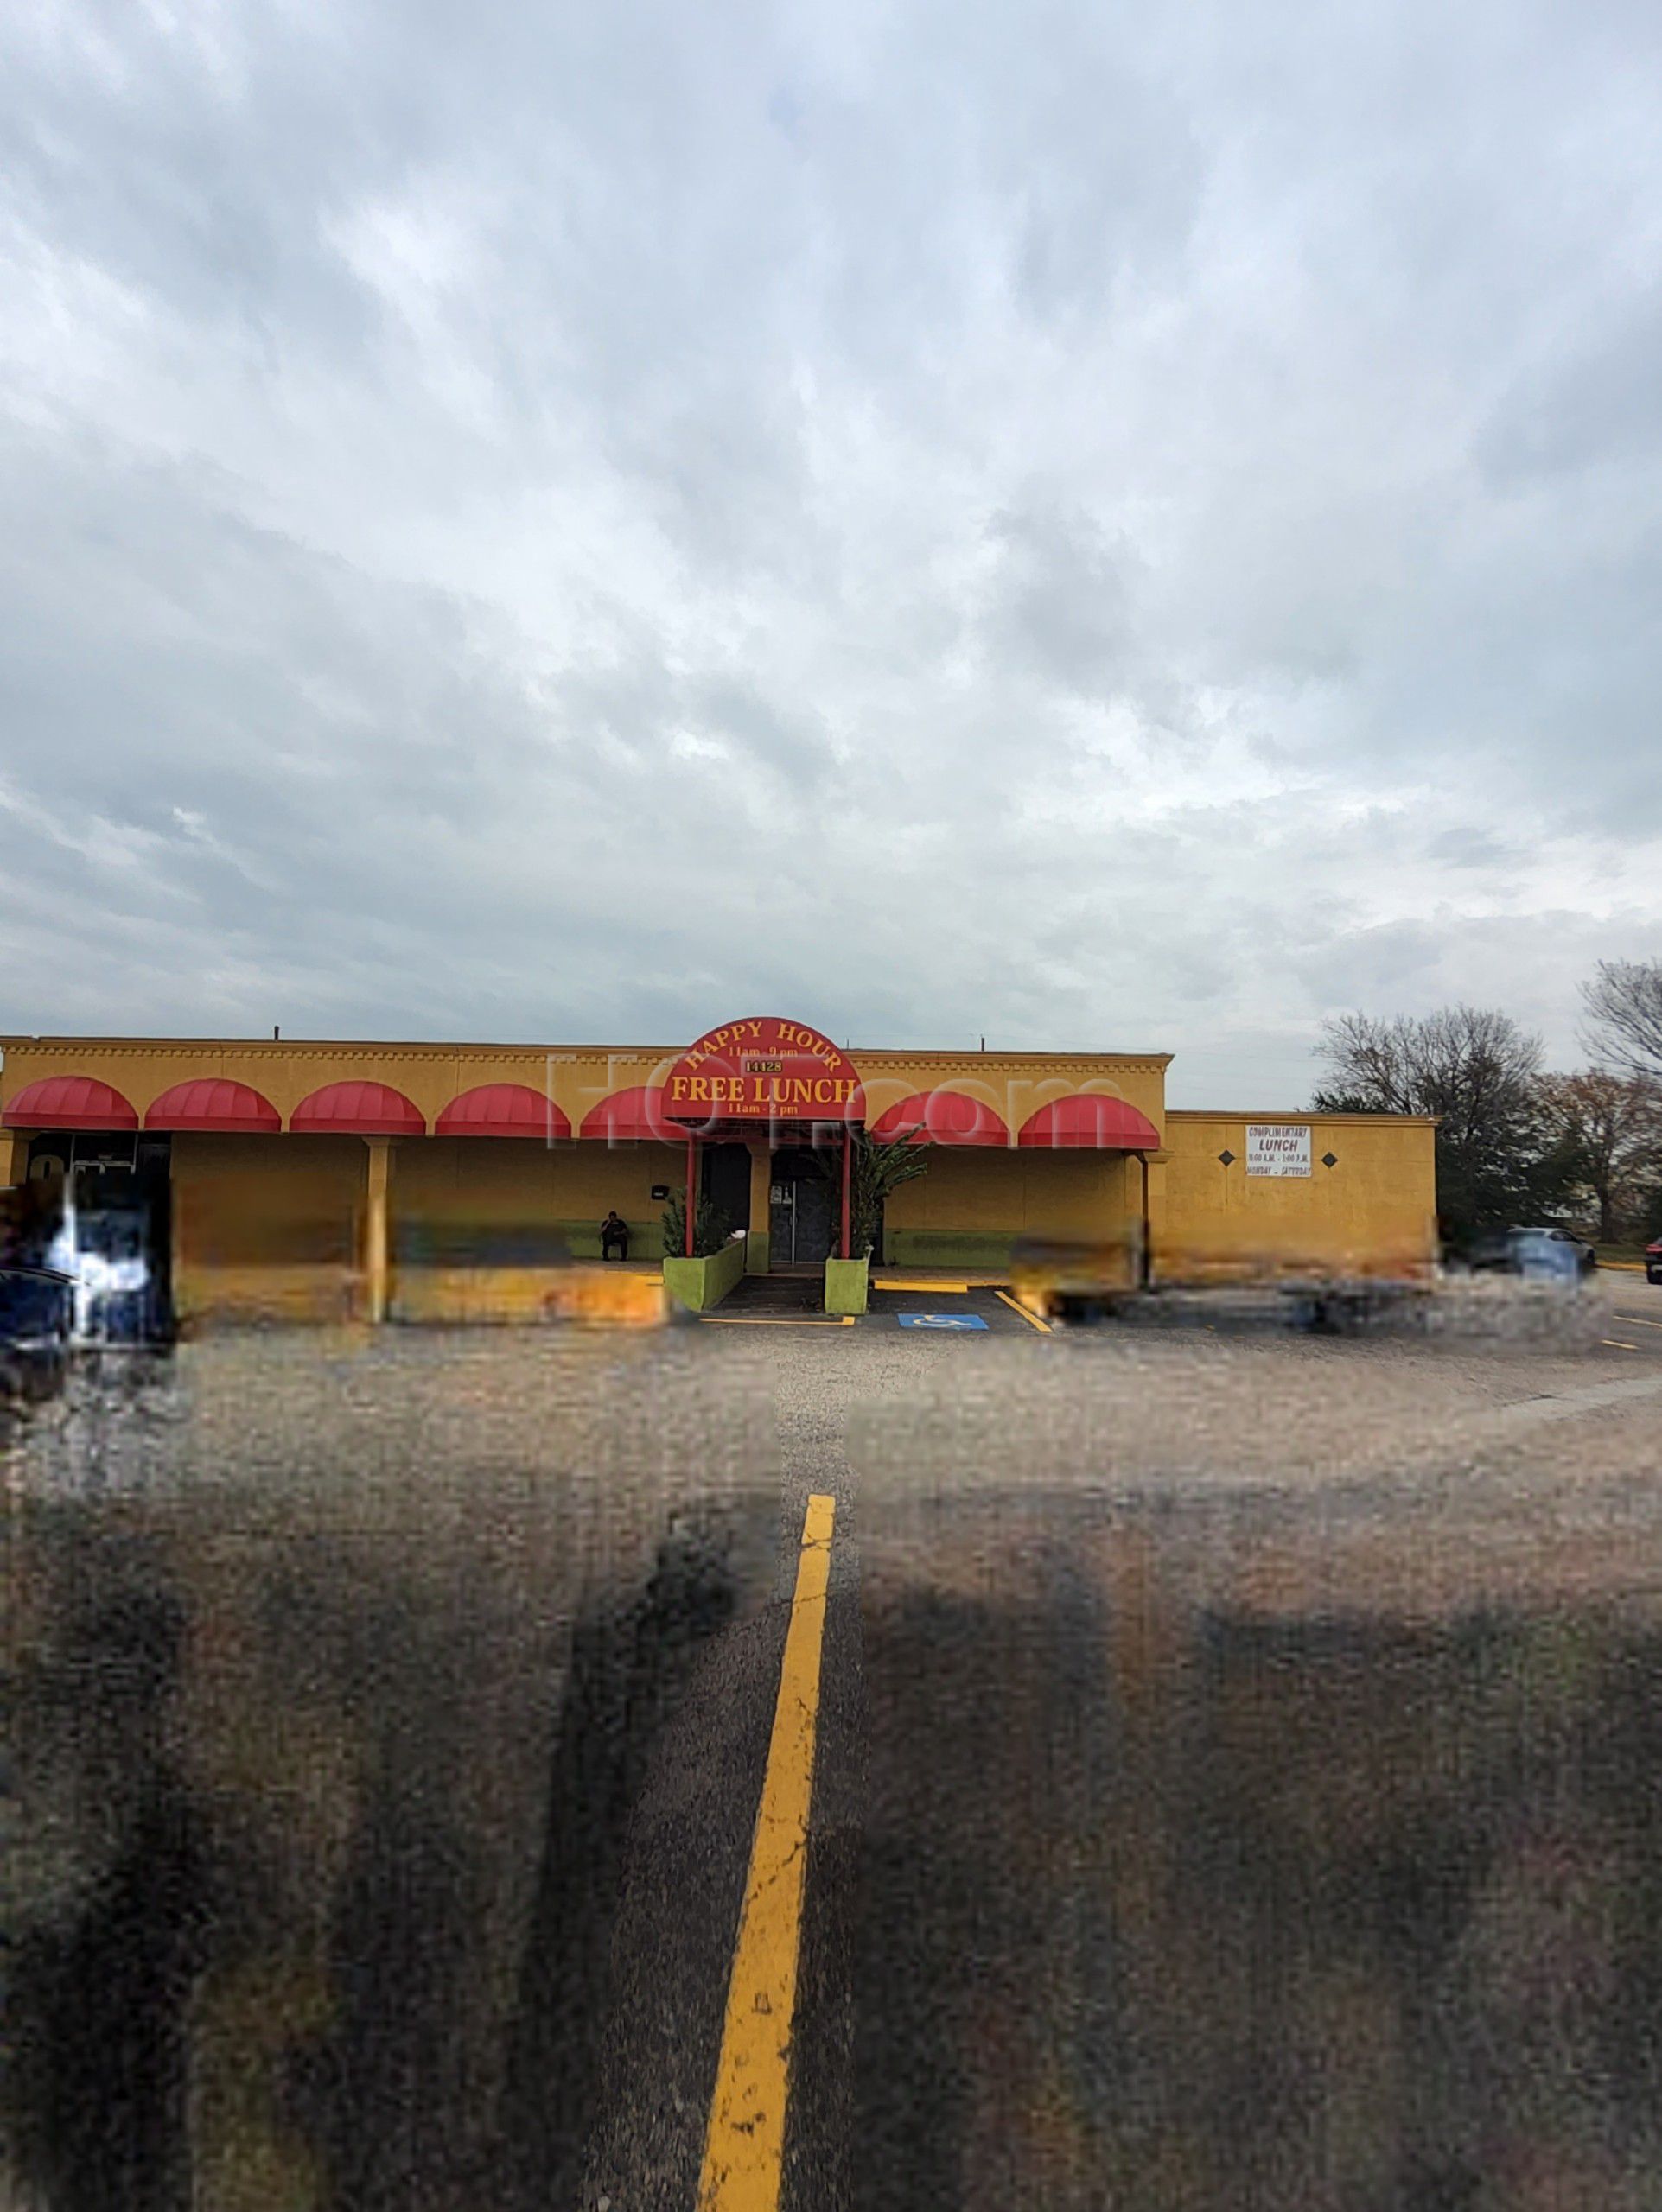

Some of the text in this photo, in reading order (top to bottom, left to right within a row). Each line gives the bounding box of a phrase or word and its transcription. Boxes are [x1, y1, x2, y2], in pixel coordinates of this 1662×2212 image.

[685, 1021, 842, 1072] HAPPY HOUR
[780, 1048, 798, 1060] pm
[746, 1061, 782, 1071] 14428
[672, 1077, 856, 1103] FREE LUNCH
[780, 1105, 798, 1117] pm
[1249, 1127, 1308, 1137] COMPLIMENTARY
[1259, 1139, 1298, 1152] LUNCH
